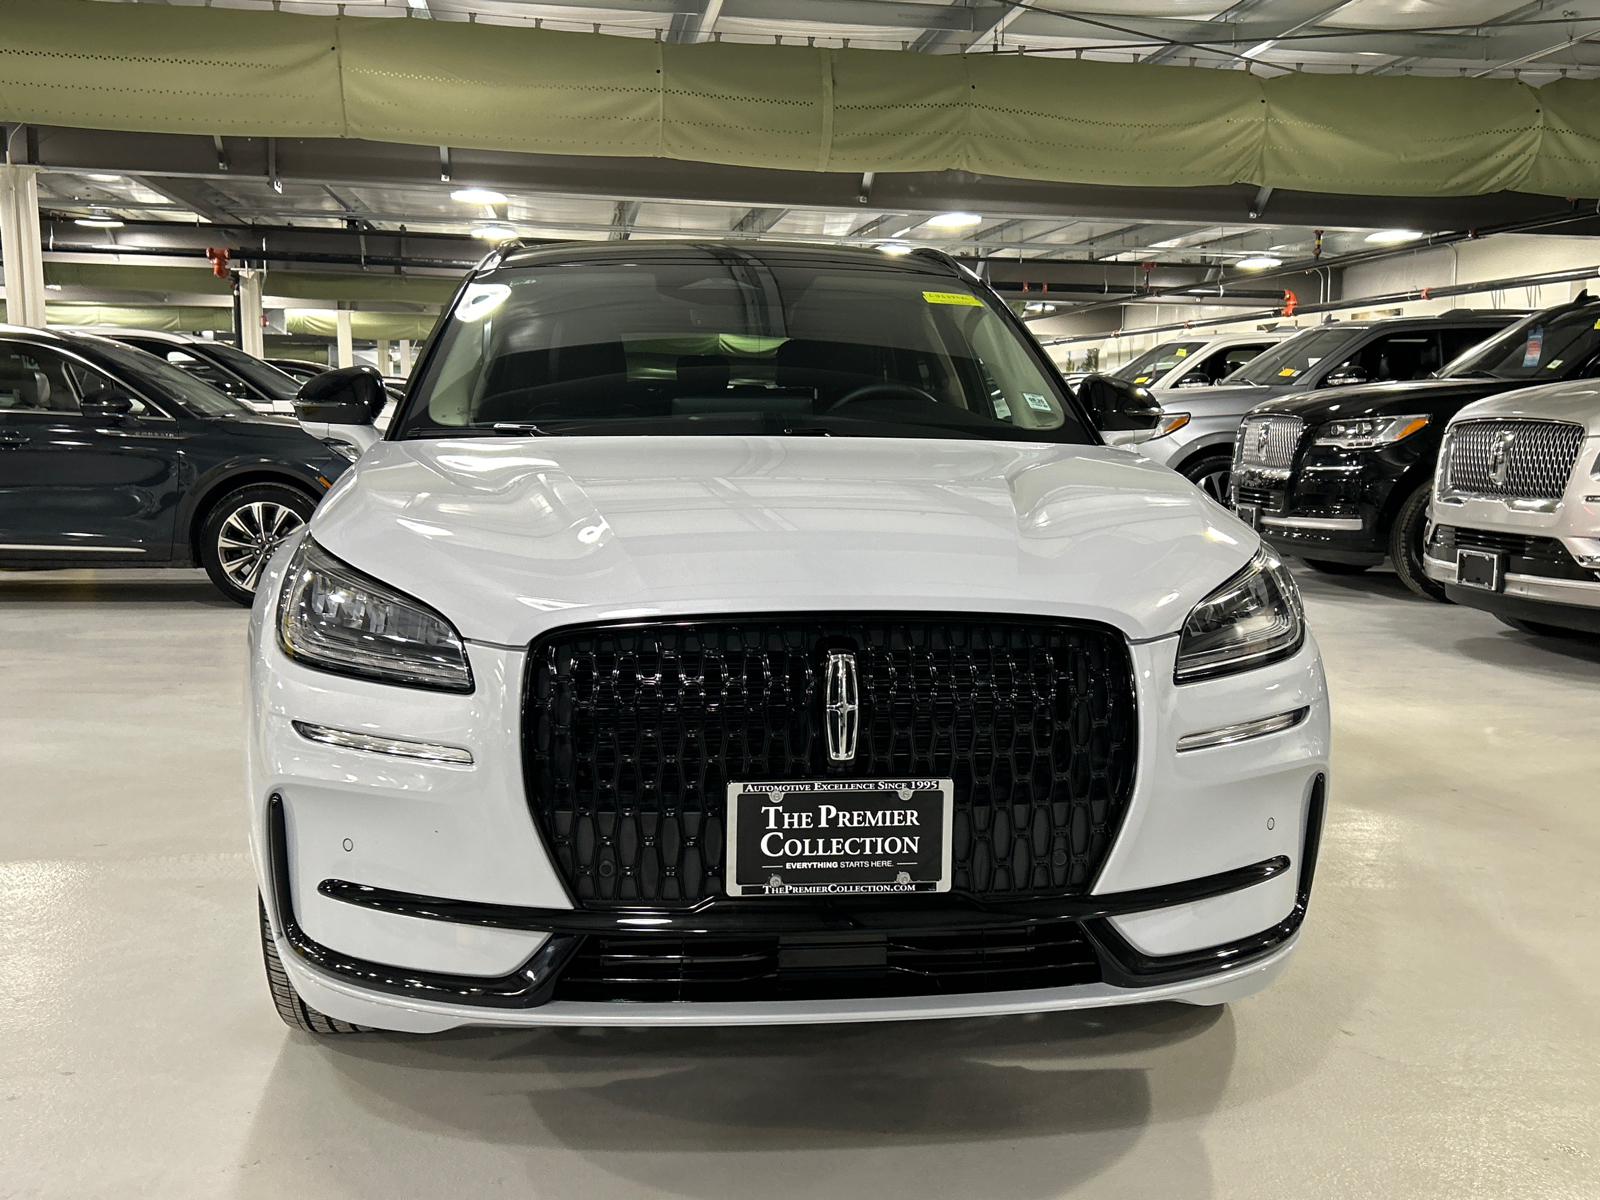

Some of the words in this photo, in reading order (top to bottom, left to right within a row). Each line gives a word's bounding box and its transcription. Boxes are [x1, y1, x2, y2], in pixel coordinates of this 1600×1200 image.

[745, 784, 811, 792] AUTOMOTIVE
[813, 782, 876, 791] EXCELLENCE
[877, 781, 907, 790] SINCE
[911, 780, 938, 789] 1995
[761, 806, 813, 829] THE
[818, 805, 920, 828] PREMIER
[760, 831, 920, 857] COLLECTION
[785, 861, 839, 870] EVERYTHING
[839, 860, 870, 869] STARTS
